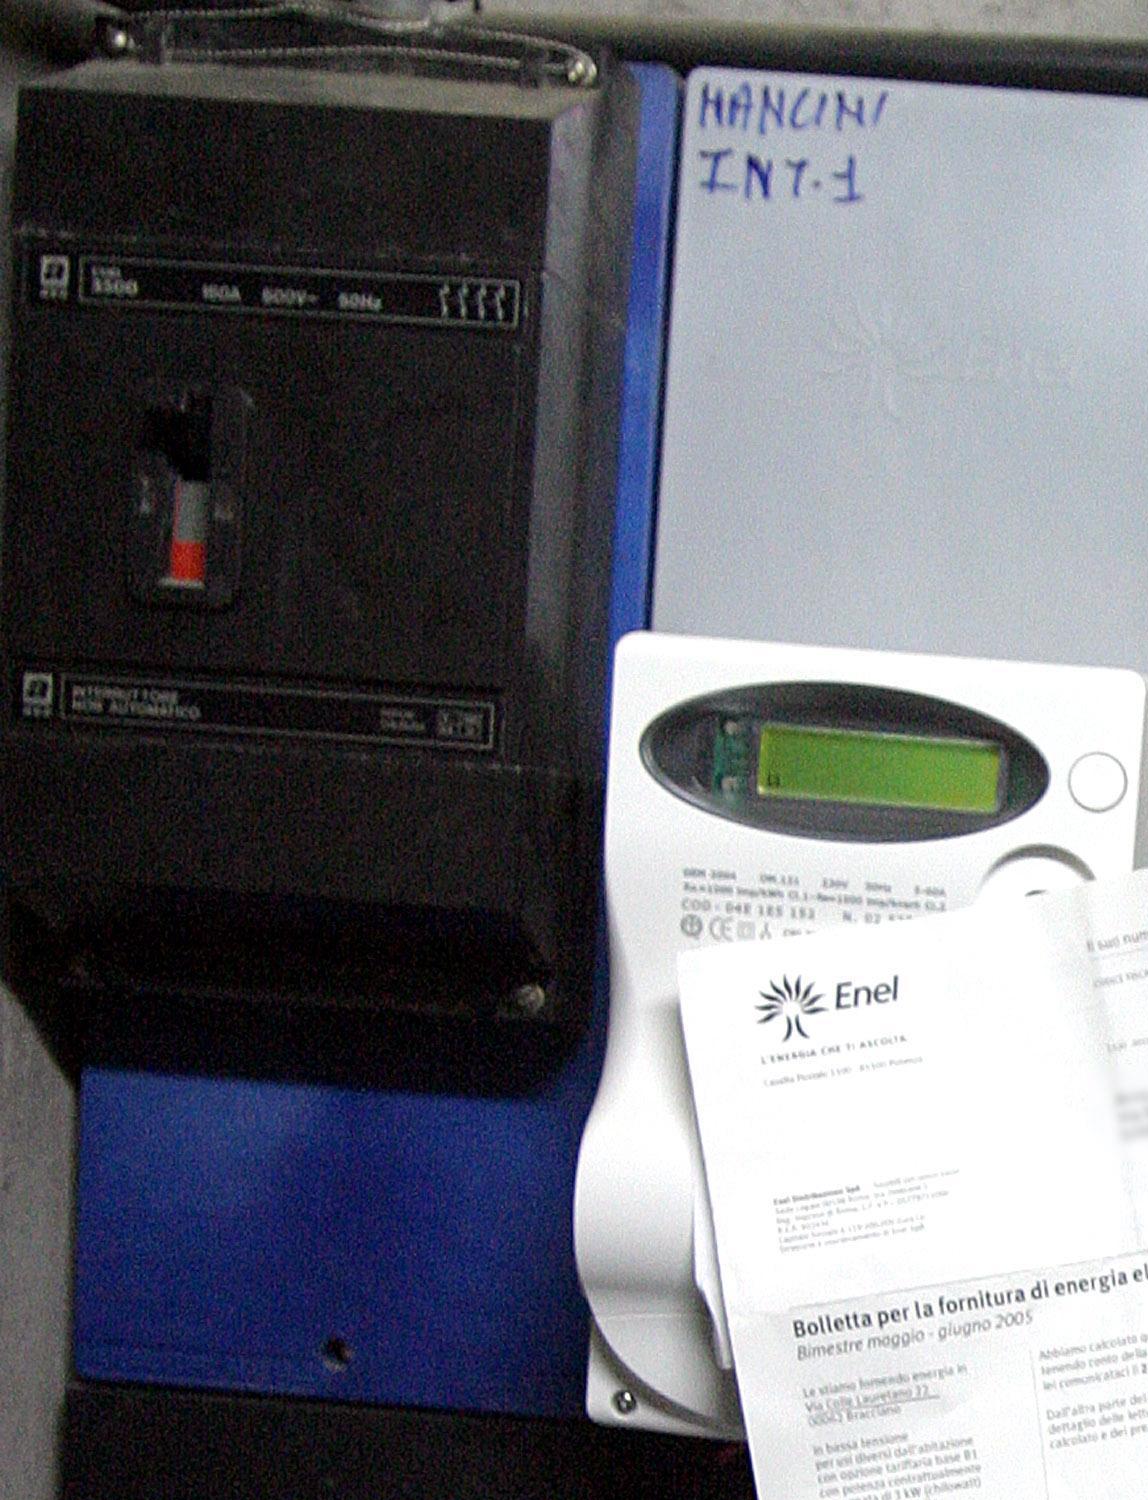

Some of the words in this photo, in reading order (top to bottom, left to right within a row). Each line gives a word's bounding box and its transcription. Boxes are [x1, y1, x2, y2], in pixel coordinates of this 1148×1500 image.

[1098, 937, 1119, 951] suo
[835, 975, 899, 1010] Enel
[793, 1313, 872, 1338] Bolletta
[878, 1308, 908, 1329] per
[915, 1301, 934, 1319] la
[939, 1289, 1025, 1314] fornitura
[1031, 1280, 1049, 1300] di
[1054, 1269, 1128, 1296] energia
[797, 1340, 863, 1361] Bimestre
[867, 1329, 925, 1349] maggio
[938, 1319, 991, 1342] giugno
[995, 1309, 1033, 1329] 2005
